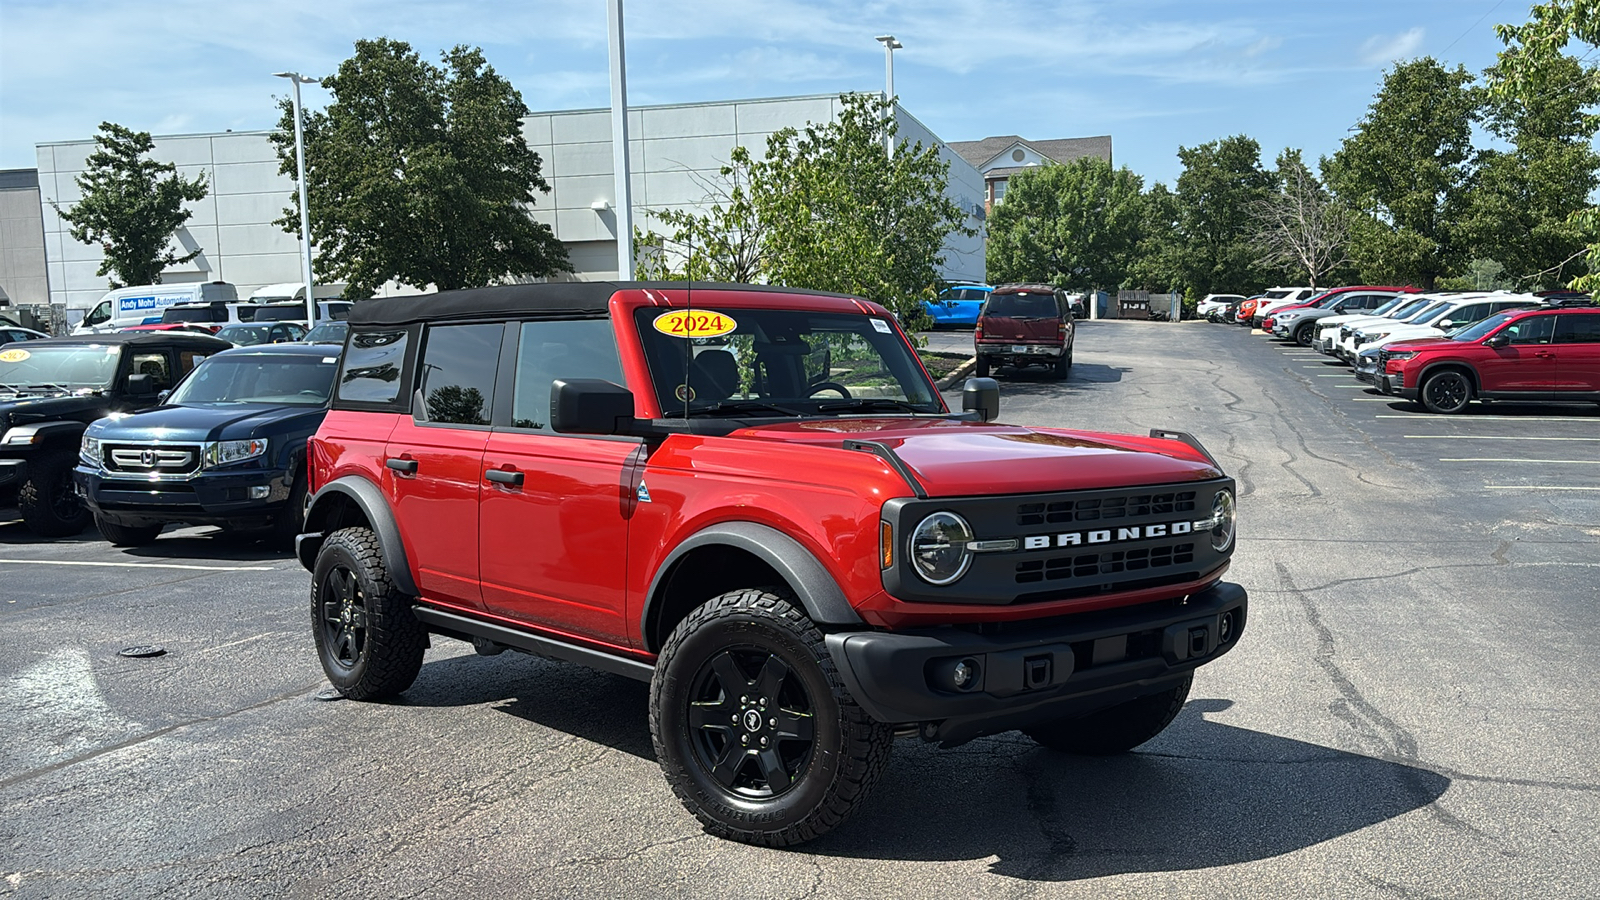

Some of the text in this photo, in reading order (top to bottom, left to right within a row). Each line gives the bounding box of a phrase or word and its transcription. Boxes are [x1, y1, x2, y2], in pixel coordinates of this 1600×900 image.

[121, 299, 137, 310] Andy
[137, 298, 154, 308] Mohr
[670, 315, 724, 333] 2024
[1024, 521, 1191, 549] BRONCO
[695, 787, 787, 824] GRABBER
